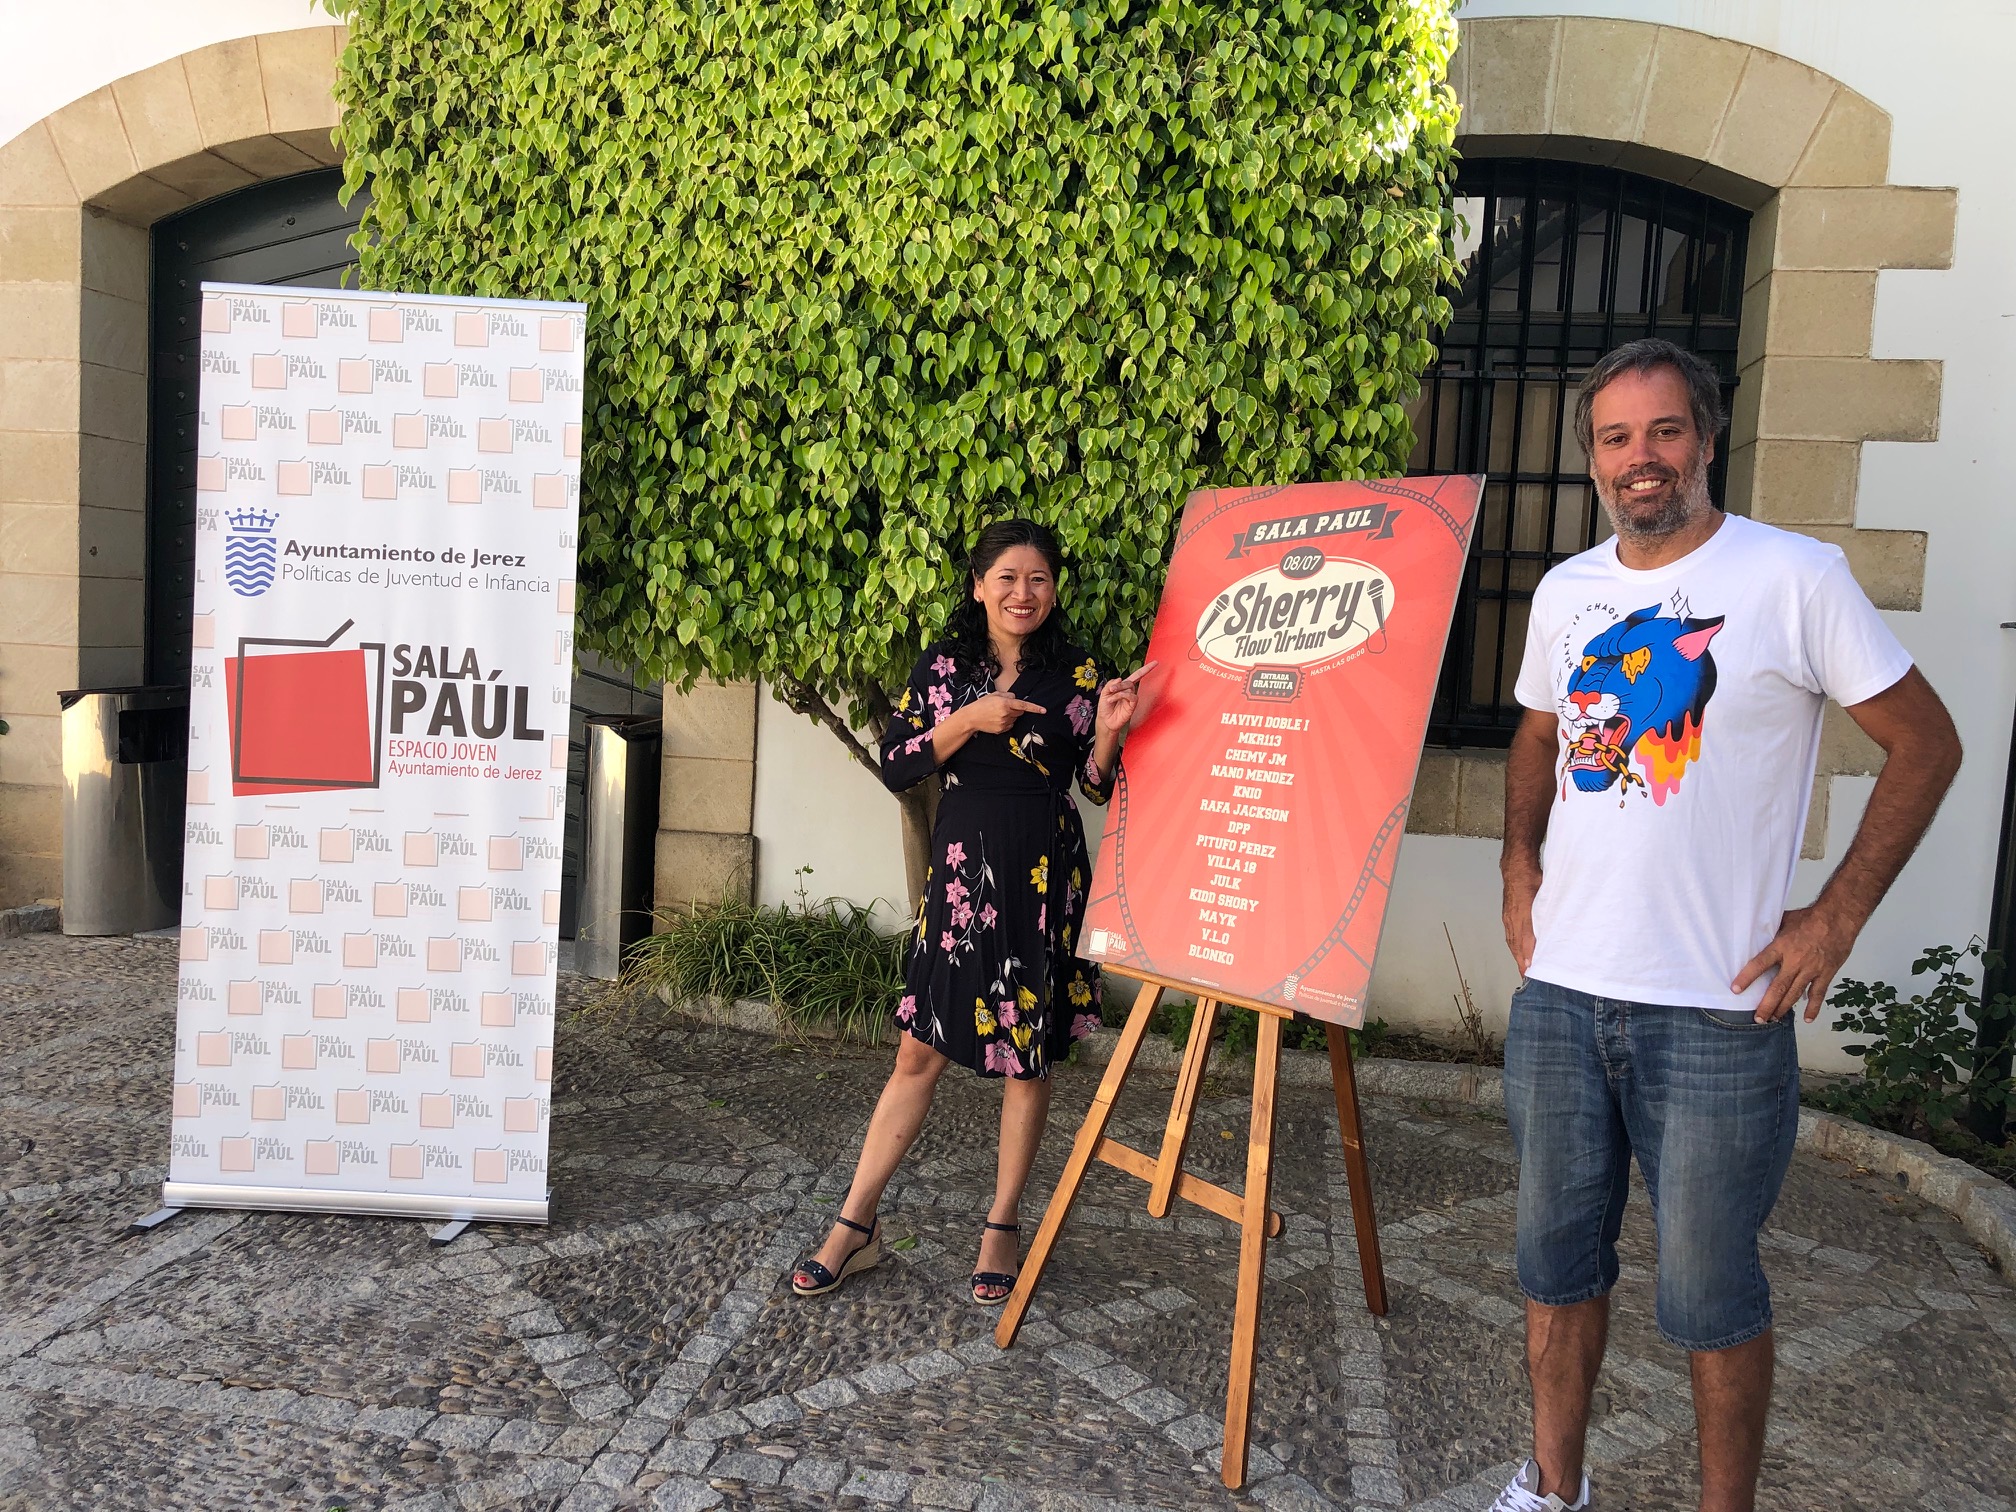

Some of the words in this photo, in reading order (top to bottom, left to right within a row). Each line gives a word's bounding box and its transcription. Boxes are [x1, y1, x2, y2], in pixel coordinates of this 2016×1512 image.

[232, 298, 256, 309] SALA
[320, 303, 342, 314] SALA
[406, 307, 428, 318] SALA
[232, 305, 271, 324] PAÚL
[319, 310, 358, 328] PAÚL
[405, 314, 444, 332] PAÚL
[490, 312, 514, 323] SALA
[490, 319, 529, 338] PAÚL
[202, 349, 226, 360] SALA
[288, 354, 312, 365] SALA
[374, 358, 398, 369] SALA
[202, 356, 241, 374] PAÚL
[288, 361, 327, 380] PAÚL
[460, 363, 482, 374] SALA
[544, 368, 568, 379] SALA
[374, 365, 413, 384] PAÚL
[459, 370, 498, 388] PAÚL
[544, 375, 583, 394] PAÚL
[258, 405, 282, 416] SALA
[344, 409, 368, 420] SALA
[430, 414, 452, 425] SALA
[258, 412, 297, 430] PAÚL
[344, 416, 383, 434] PAÚL
[514, 418, 538, 429] SALA
[429, 421, 468, 440] PAÚL
[514, 425, 553, 444] PAÚL
[228, 456, 252, 467] SALA
[314, 460, 336, 471] SALA
[398, 464, 422, 475] SALA
[228, 463, 267, 482] PAÚL
[313, 467, 352, 486] PAÚL
[398, 471, 437, 490] PAÚL
[484, 469, 506, 480] SALA
[483, 476, 522, 494] PAÚL
[1253, 518, 1307, 542] SALA
[1314, 509, 1373, 533] PAUL
[284, 540, 435, 562] Ayuntamiento
[441, 547, 466, 563] de
[471, 548, 526, 569] Jerez
[1282, 555, 1322, 572] 08/07
[283, 563, 351, 583] Políticas
[358, 567, 379, 583] de
[384, 568, 462, 588] Juventud
[469, 577, 479, 588] e
[485, 573, 551, 593] Infancia
[1224, 580, 1366, 640] Sherry
[1586, 603, 1619, 620] CHAOS
[1234, 634, 1273, 659] Flow
[1274, 629, 1327, 653] Urban
[392, 643, 481, 681] SALA
[1199, 663, 1217, 675] DESDE
[1216, 671, 1227, 679] LAS
[1310, 664, 1331, 677] HASTA
[1332, 658, 1345, 669] LAS
[1346, 648, 1365, 662] 00:00
[1252, 680, 1293, 690] GRATUITA
[1260, 672, 1289, 680] ENTRADA
[390, 669, 544, 741] PAÚL
[1221, 712, 1263, 727] HAVIVI
[1264, 716, 1302, 731] DOBLE
[1303, 719, 1310, 731] I
[1237, 731, 1282, 747] MKR113
[388, 740, 447, 759] ESPACIO
[450, 743, 497, 762] JOVEN
[1268, 753, 1288, 766] JM
[388, 760, 480, 778] Ayuntamiento
[483, 765, 500, 778] de
[504, 765, 542, 780] Jerez
[1210, 765, 1244, 779] NANO
[1245, 768, 1295, 786] MENDEZ
[1232, 785, 1262, 800] KNIO
[1200, 799, 1230, 814] RAFA
[1233, 803, 1289, 822] JACKSON
[186, 820, 210, 831] SALA
[270, 824, 294, 835] SALA
[356, 827, 378, 838] SALA
[1227, 820, 1251, 835] DPP
[186, 827, 225, 846] PAÚL
[270, 831, 309, 850] PAÚL
[355, 834, 394, 852] PAÚL
[440, 831, 462, 842] SALA
[524, 835, 548, 846] SALA
[439, 838, 478, 856] PAÚL
[524, 842, 563, 860] PAÚL
[1196, 834, 1237, 852] PITUFO
[1238, 841, 1276, 858] PEREZ
[1207, 854, 1240, 872] VILLA
[1243, 861, 1257, 874] 18
[240, 875, 264, 886] SALA
[326, 878, 348, 889] SALA
[410, 882, 432, 893] SALA
[1210, 874, 1242, 890] JULK
[240, 882, 279, 900] PAÚL
[325, 885, 364, 904] PAÚL
[409, 889, 448, 908] PAÚL
[494, 886, 516, 897] SALA
[1189, 887, 1216, 904] KIDD
[1217, 893, 1259, 912] SHORY
[493, 893, 532, 912] PAÚL
[1199, 908, 1237, 927] MAYK
[210, 926, 232, 937] SALA
[294, 929, 318, 940] SALA
[378, 933, 402, 944] SALA
[1202, 927, 1230, 945] V.L.O
[209, 933, 248, 952] PAÚL
[294, 936, 333, 954] PAÚL
[378, 940, 417, 958] PAÚL
[464, 937, 486, 948] SALA
[463, 944, 502, 962] PAÚL
[1188, 943, 1234, 966] BLONKO
[179, 984, 218, 1002] PAÚL
[264, 980, 288, 991] SALA
[348, 983, 372, 994] SALA
[432, 988, 456, 999] SALA
[1299, 984, 1336, 998] Ayuntamiento
[1343, 995, 1358, 1003] Jerez
[264, 987, 303, 1006] PAÚL
[348, 990, 387, 1008] PAÚL
[432, 995, 471, 1014] PAÚL
[516, 992, 540, 1003] SALA
[516, 999, 555, 1018] PAÚL
[234, 1031, 256, 1042] SALA
[318, 1034, 342, 1045] SALA
[402, 1038, 426, 1049] SALA
[233, 1038, 272, 1056] PAÚL
[318, 1041, 357, 1060] PAÚL
[402, 1045, 441, 1064] PAÚL
[486, 1042, 510, 1053] SALA
[486, 1049, 525, 1068] PAÚL
[202, 1082, 226, 1093] SALA
[288, 1085, 310, 1096] SALA
[372, 1089, 394, 1100] SALA
[202, 1089, 241, 1108] PAÚL
[287, 1092, 326, 1110] PAÚL
[371, 1096, 410, 1114] PAÚL
[456, 1093, 478, 1104] SALA
[455, 1100, 494, 1118] PAÚL
[256, 1136, 280, 1147] SALA
[342, 1140, 364, 1151] SALA
[426, 1144, 448, 1155] SALA
[256, 1143, 295, 1162] PAÚL
[341, 1147, 380, 1166] PAÚL
[425, 1151, 464, 1170] PAÚL
